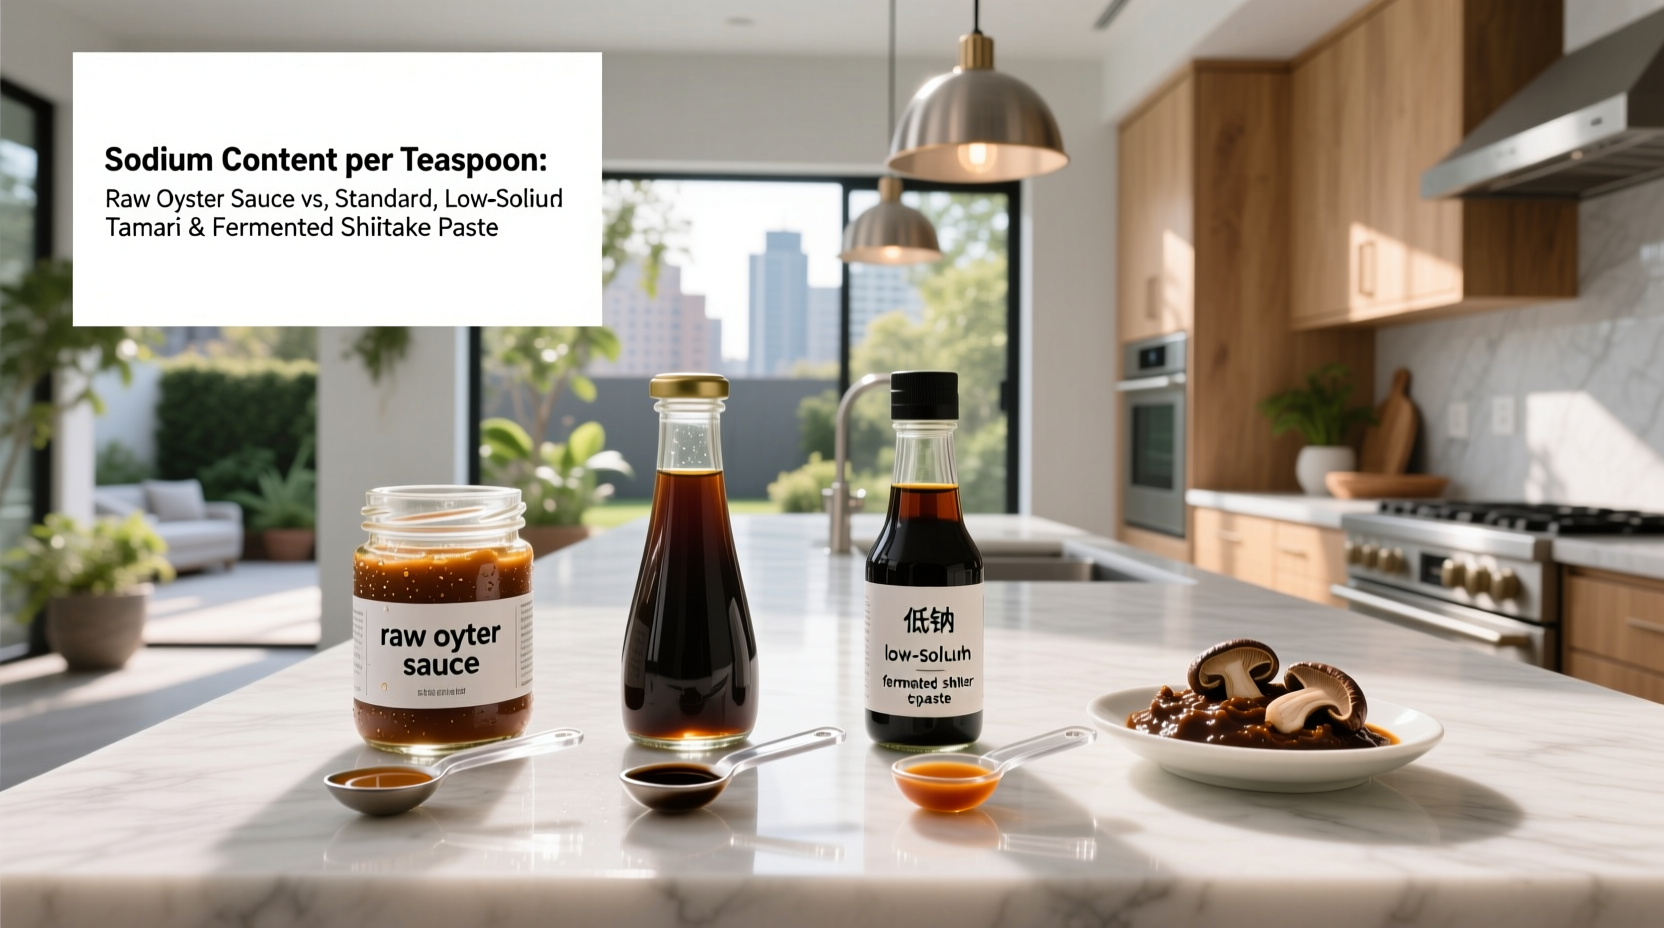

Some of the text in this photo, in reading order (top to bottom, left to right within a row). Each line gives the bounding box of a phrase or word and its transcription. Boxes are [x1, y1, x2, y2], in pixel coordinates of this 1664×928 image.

[903, 606, 955, 634] 低钠
[380, 623, 502, 654] raw oyter
[403, 655, 480, 677] sauce
